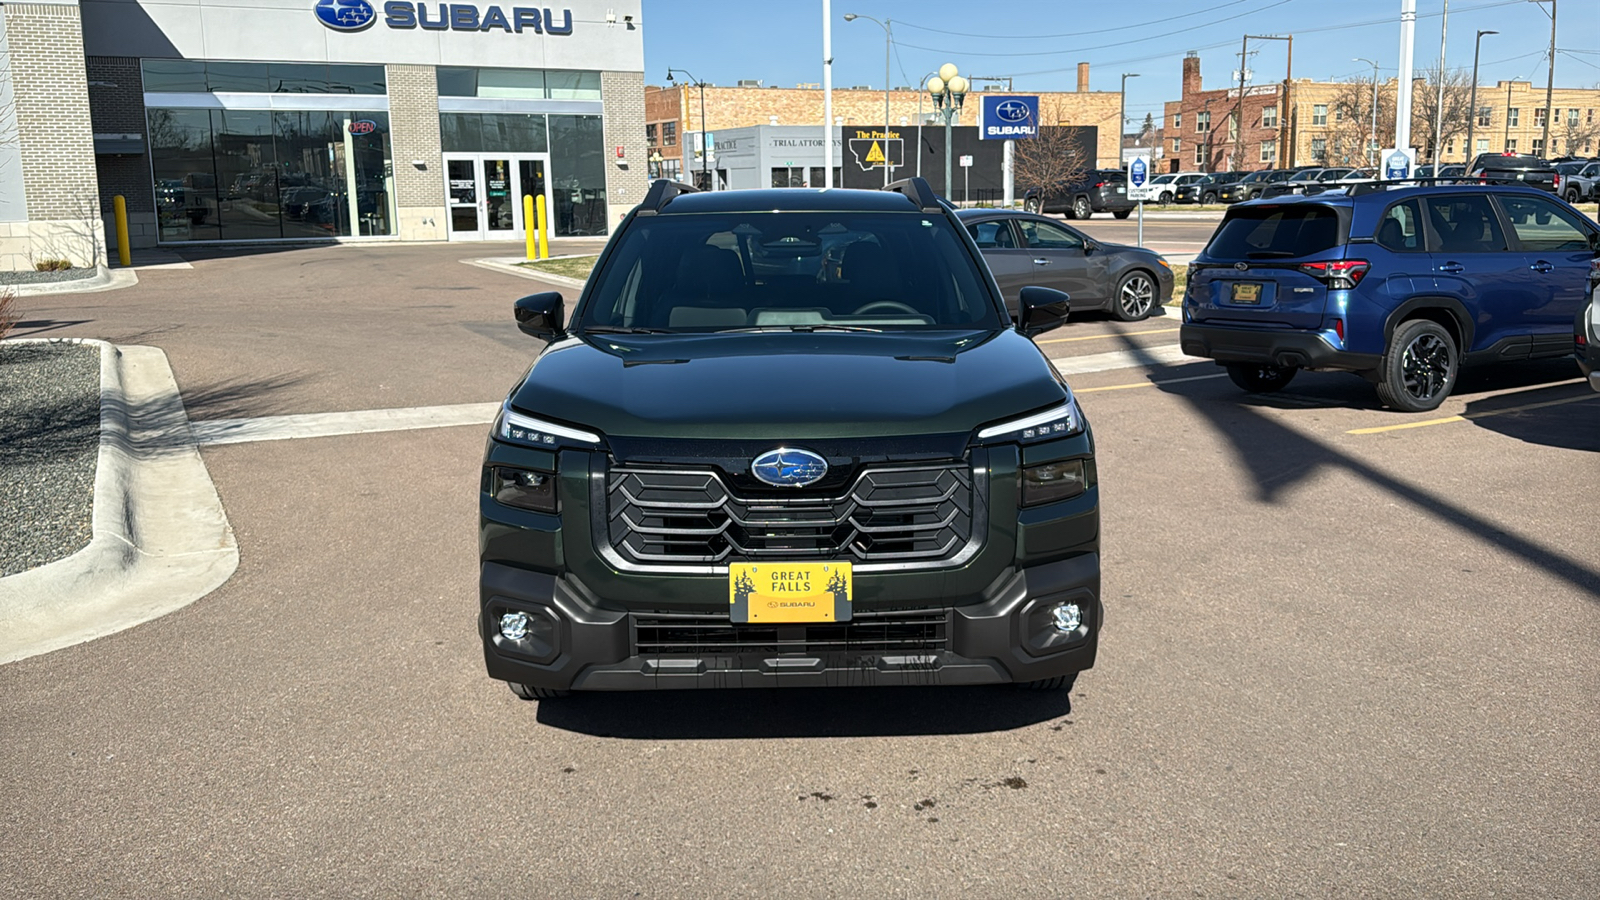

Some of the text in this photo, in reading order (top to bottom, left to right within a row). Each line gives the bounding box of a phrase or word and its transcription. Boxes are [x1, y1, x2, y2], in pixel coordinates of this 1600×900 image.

[384, 1, 573, 35] SUBARU
[349, 121, 374, 133] OPEN
[987, 126, 1036, 135] SUBARU
[856, 131, 870, 139] The
[773, 139, 842, 147] TRIAL ATTORYS
[771, 571, 811, 581] GREAT
[771, 581, 811, 592] FALLS
